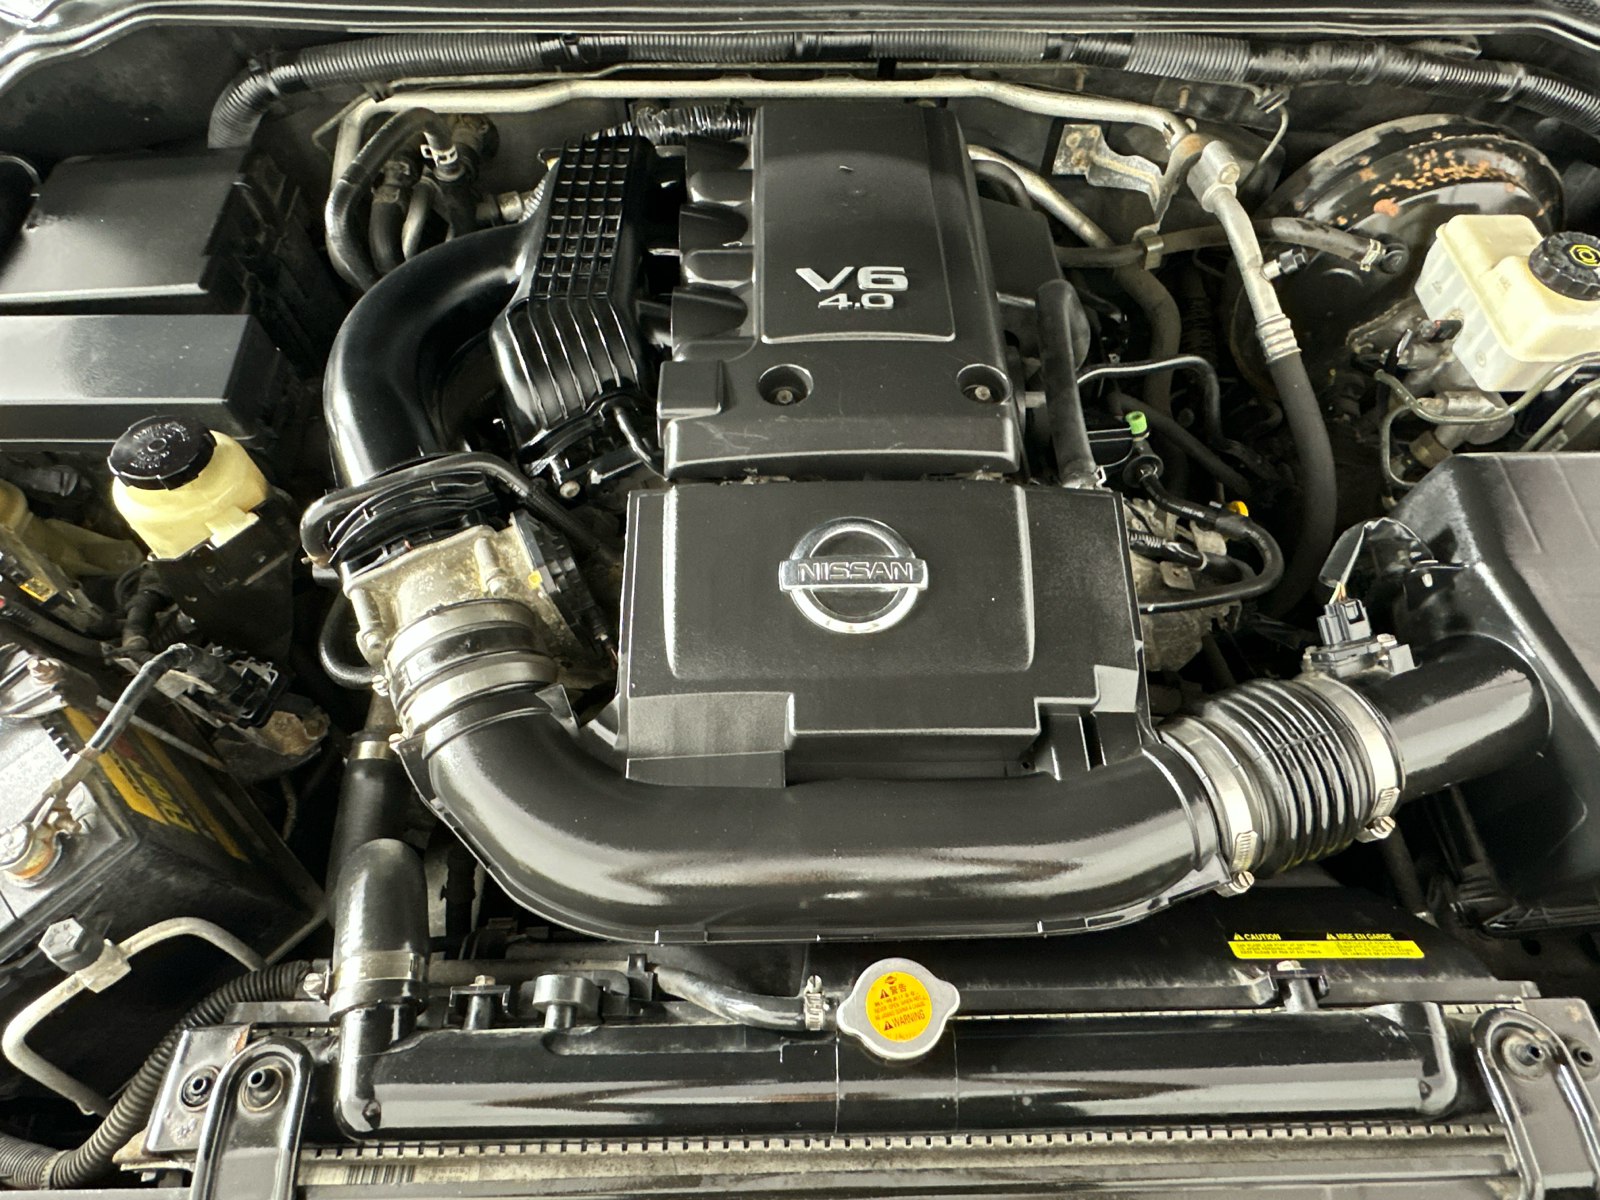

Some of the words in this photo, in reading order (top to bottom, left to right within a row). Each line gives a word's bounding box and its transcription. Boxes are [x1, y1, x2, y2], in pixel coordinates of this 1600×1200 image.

[795, 266, 908, 292] V6
[818, 293, 894, 310] 4.0
[797, 561, 913, 582] NISSAN
[1243, 933, 1282, 941] CAUTION
[892, 1009, 926, 1028] WARNING
